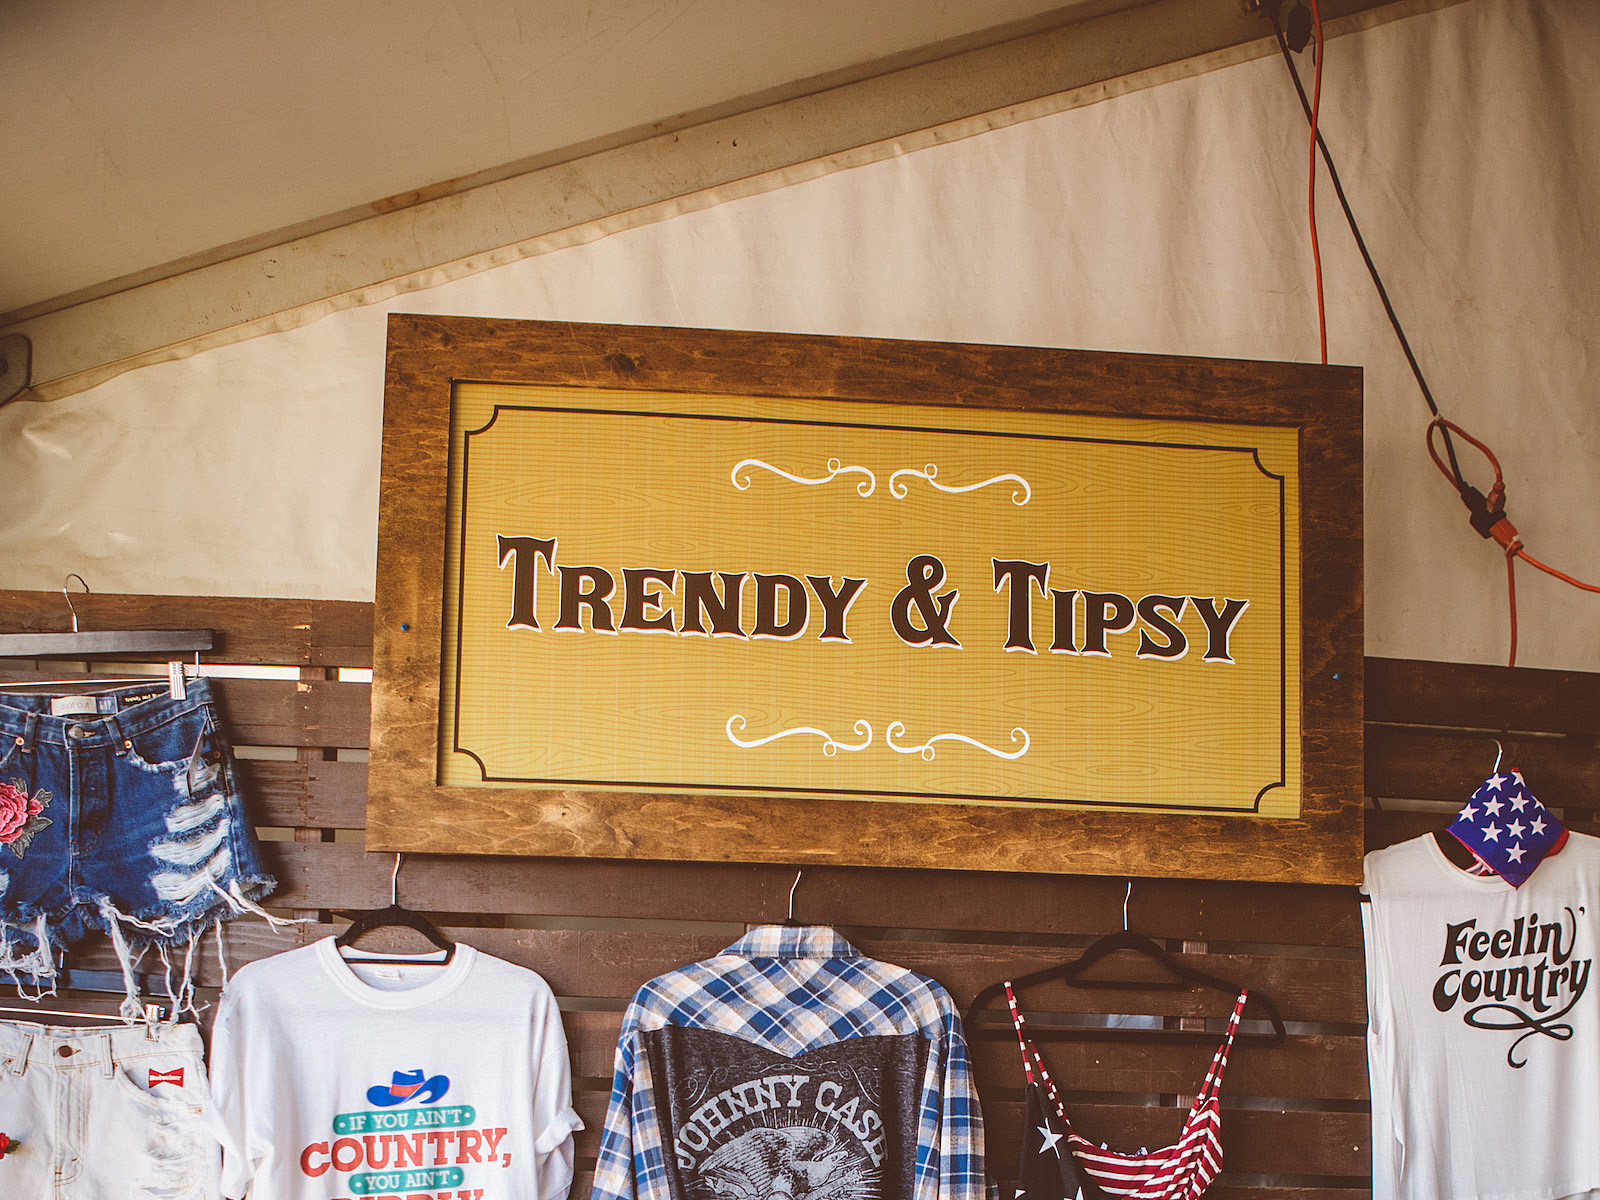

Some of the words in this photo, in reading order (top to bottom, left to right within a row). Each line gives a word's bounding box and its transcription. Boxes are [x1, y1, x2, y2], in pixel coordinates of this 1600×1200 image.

[889, 553, 964, 650] &
[1440, 906, 1586, 967] Feelin'
[349, 1115, 366, 1131] IF
[372, 1112, 409, 1129] YOU
[414, 1108, 462, 1126] AIN'T
[674, 1075, 809, 1170] JOHNNY
[300, 1127, 512, 1178] COUNTRY,
[365, 1174, 400, 1191] YOU
[405, 1170, 450, 1189] AIN'T
